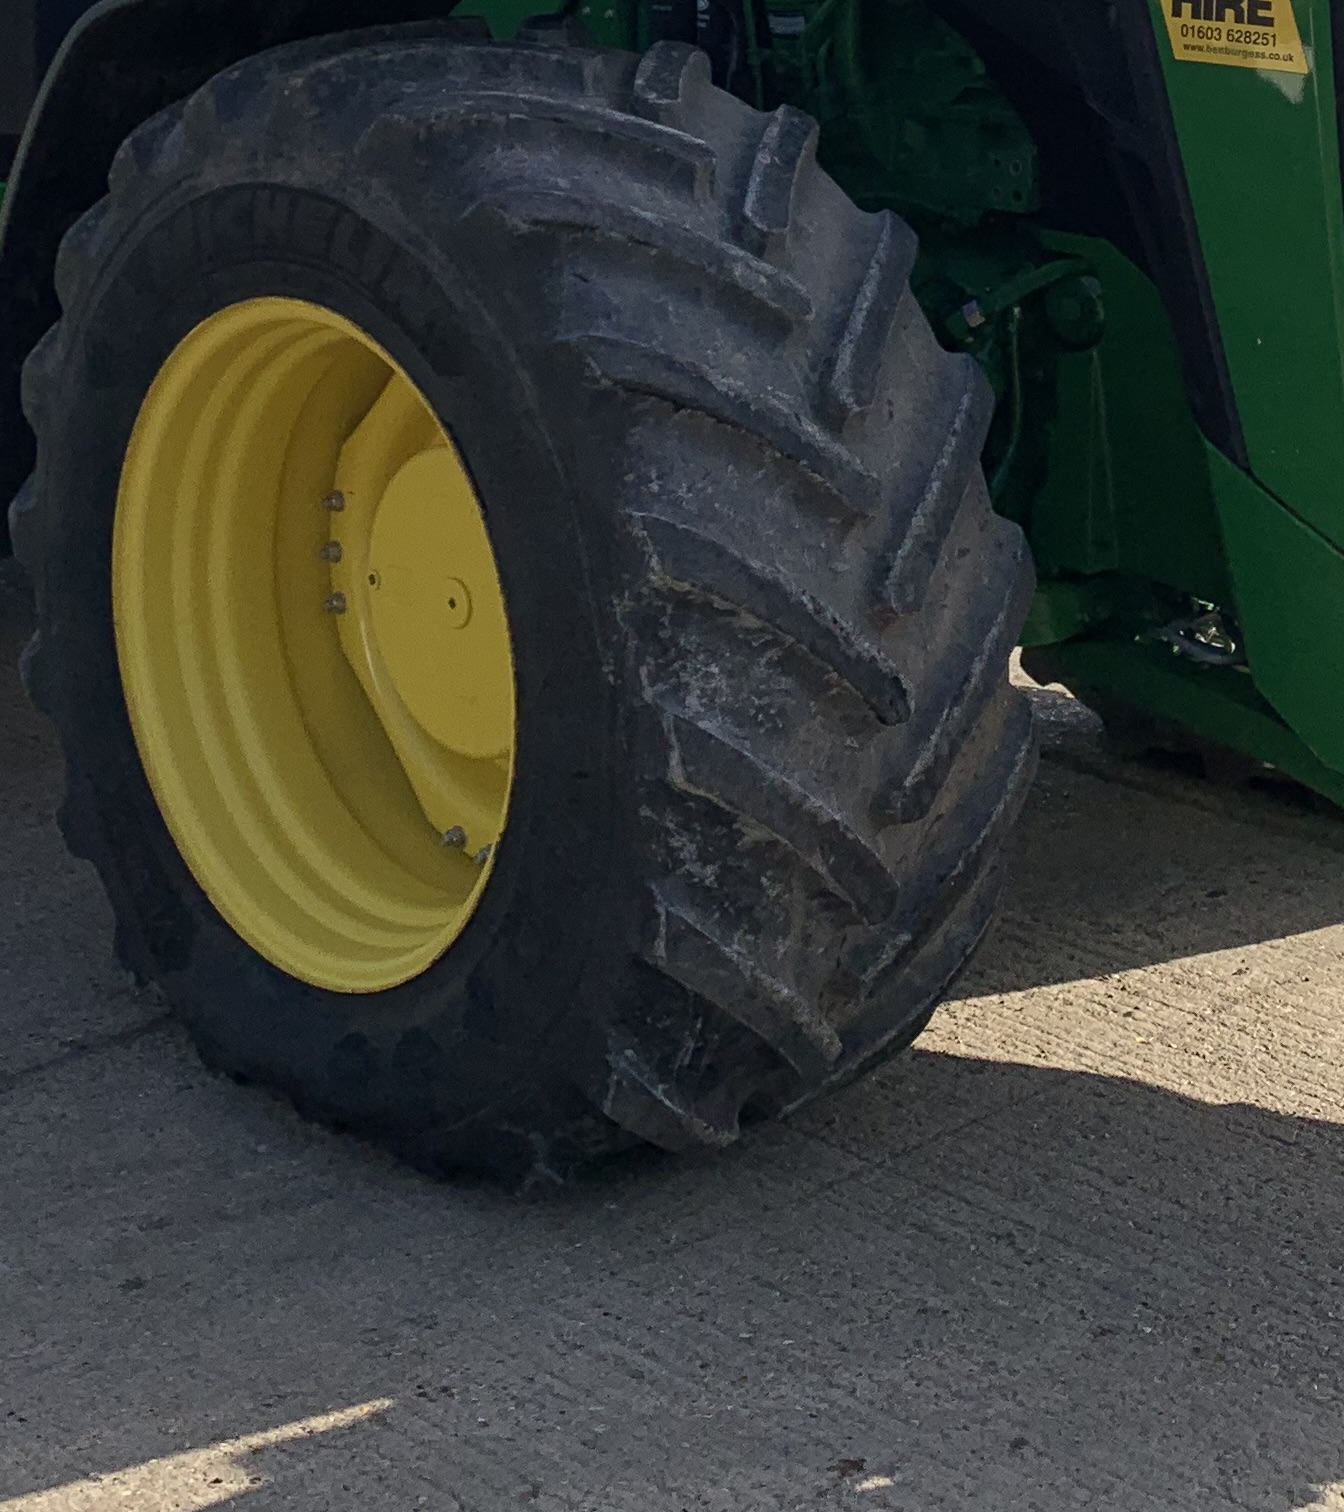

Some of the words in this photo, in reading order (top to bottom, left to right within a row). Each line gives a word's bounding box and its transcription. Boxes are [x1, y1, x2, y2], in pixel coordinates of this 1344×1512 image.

[1180, 23, 1222, 41] 01603
[1226, 28, 1277, 48] 628251
[1183, 43, 1295, 63] www.benburgess.co.uk
